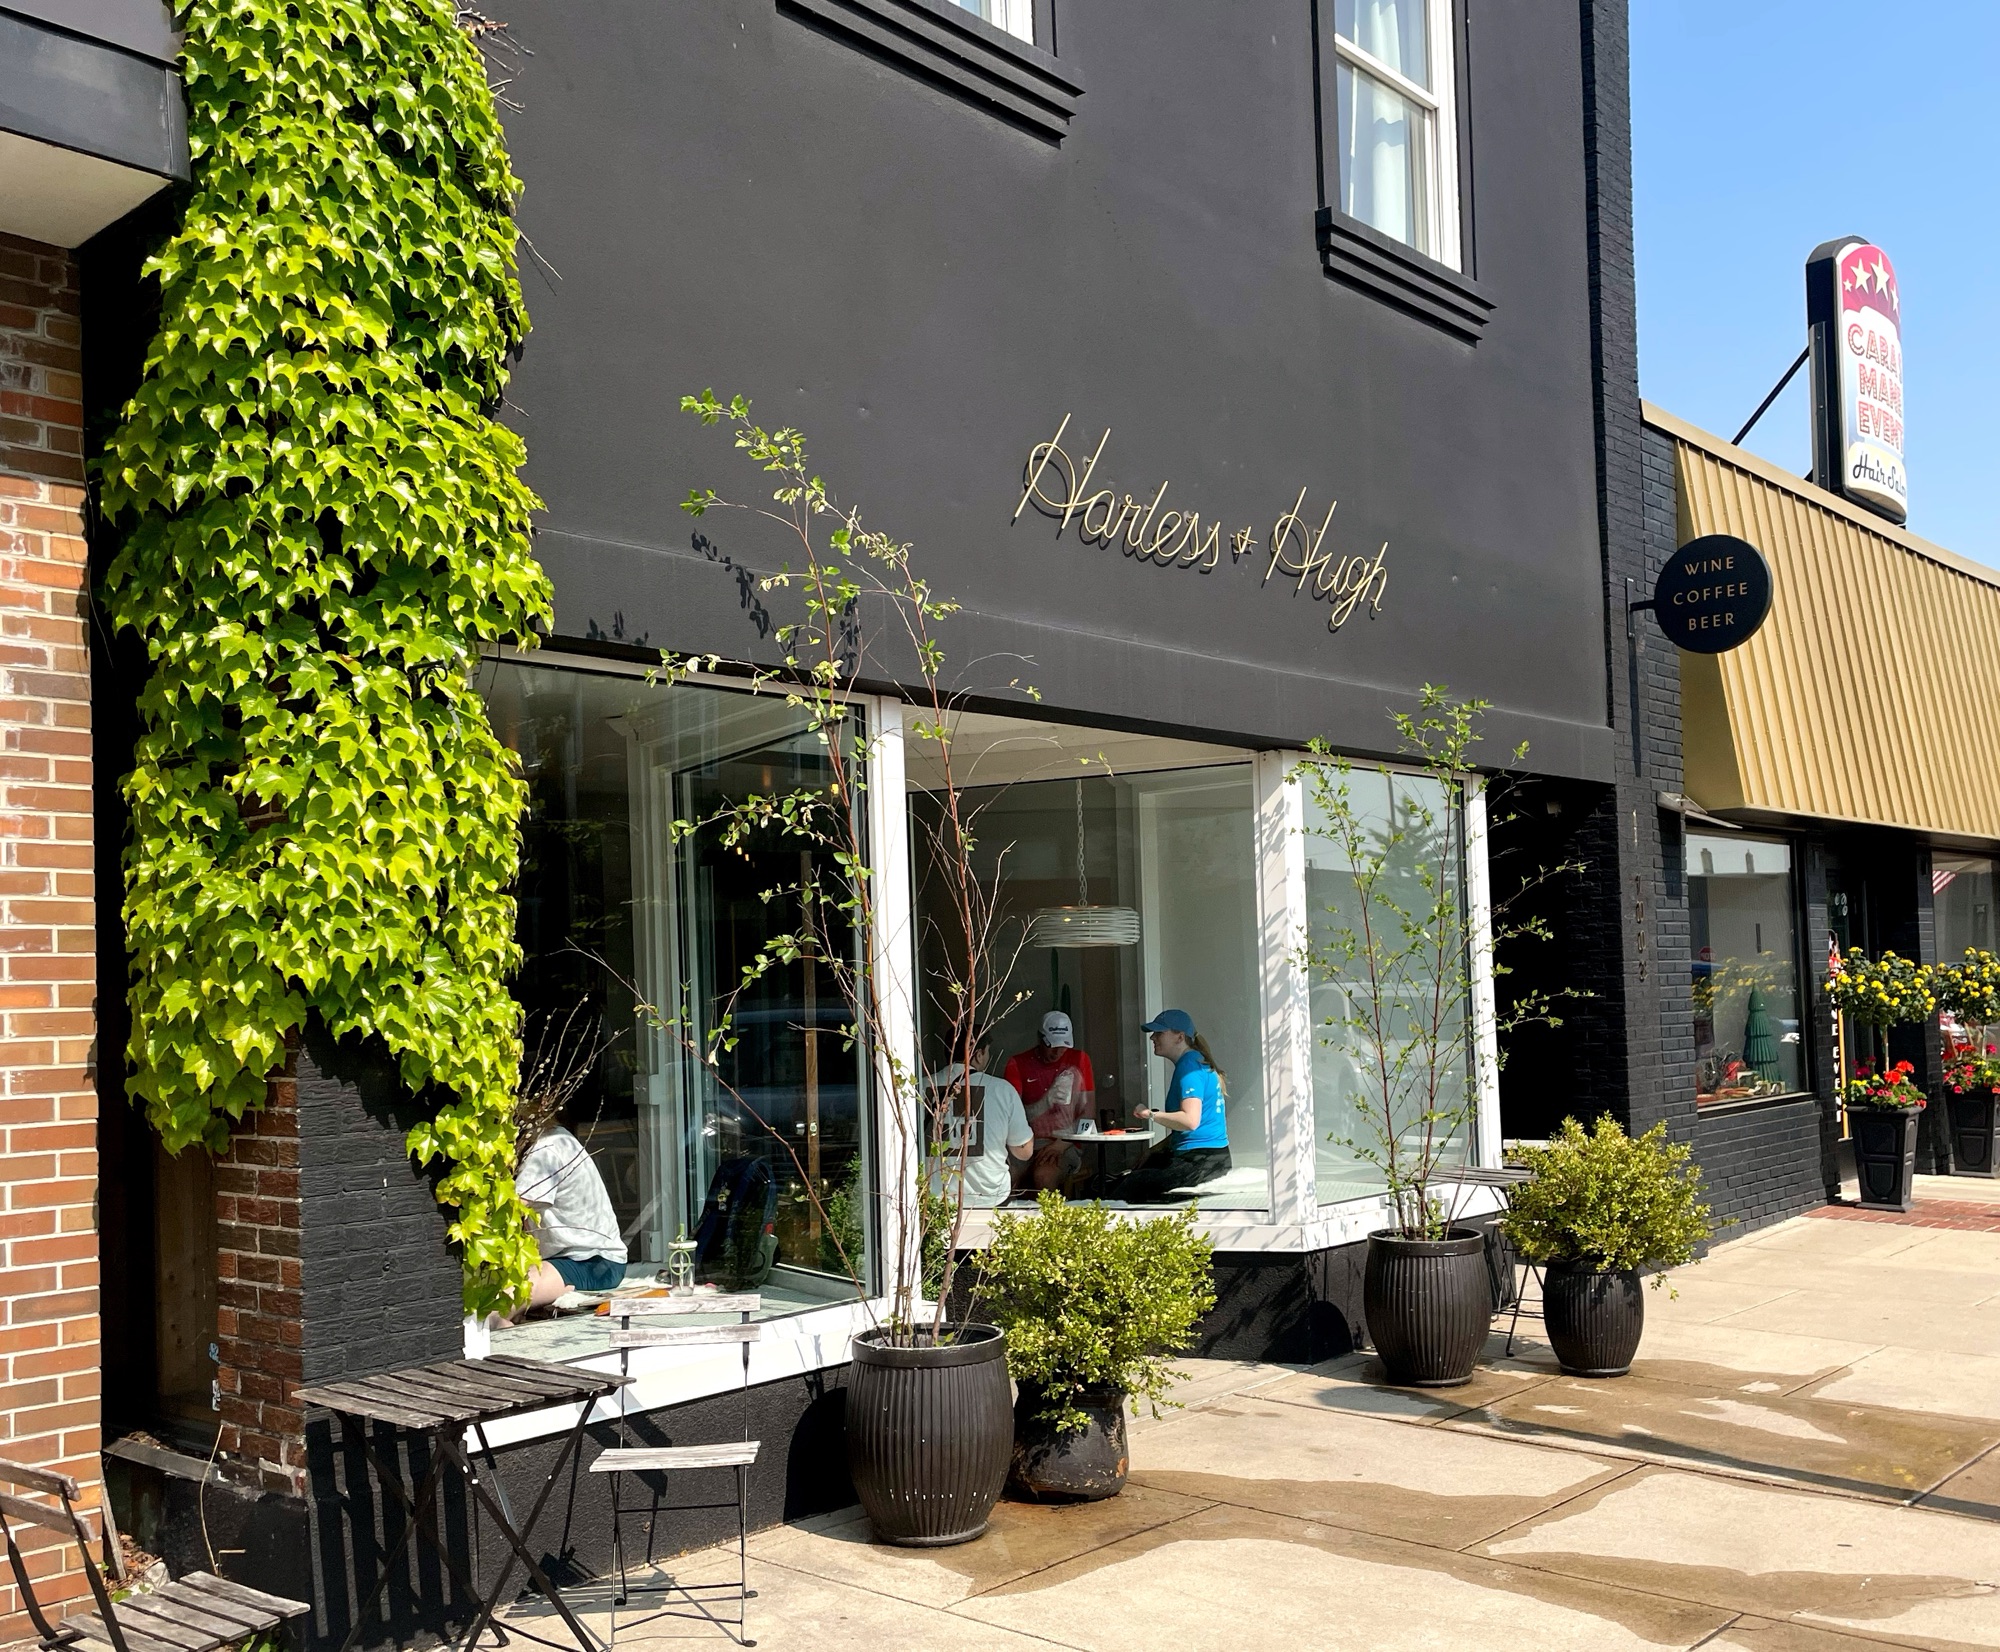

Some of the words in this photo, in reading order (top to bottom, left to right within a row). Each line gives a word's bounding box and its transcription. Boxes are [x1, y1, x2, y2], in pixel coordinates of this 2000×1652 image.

[1852, 451, 1886, 486] Hair
[1015, 412, 1222, 568] Harless
[1265, 486, 1389, 628] Hugh
[1684, 556, 1735, 576] WINE
[1673, 582, 1748, 605] COFFEE
[1688, 612, 1735, 631] BEER
[1081, 1122, 1090, 1132] 19
